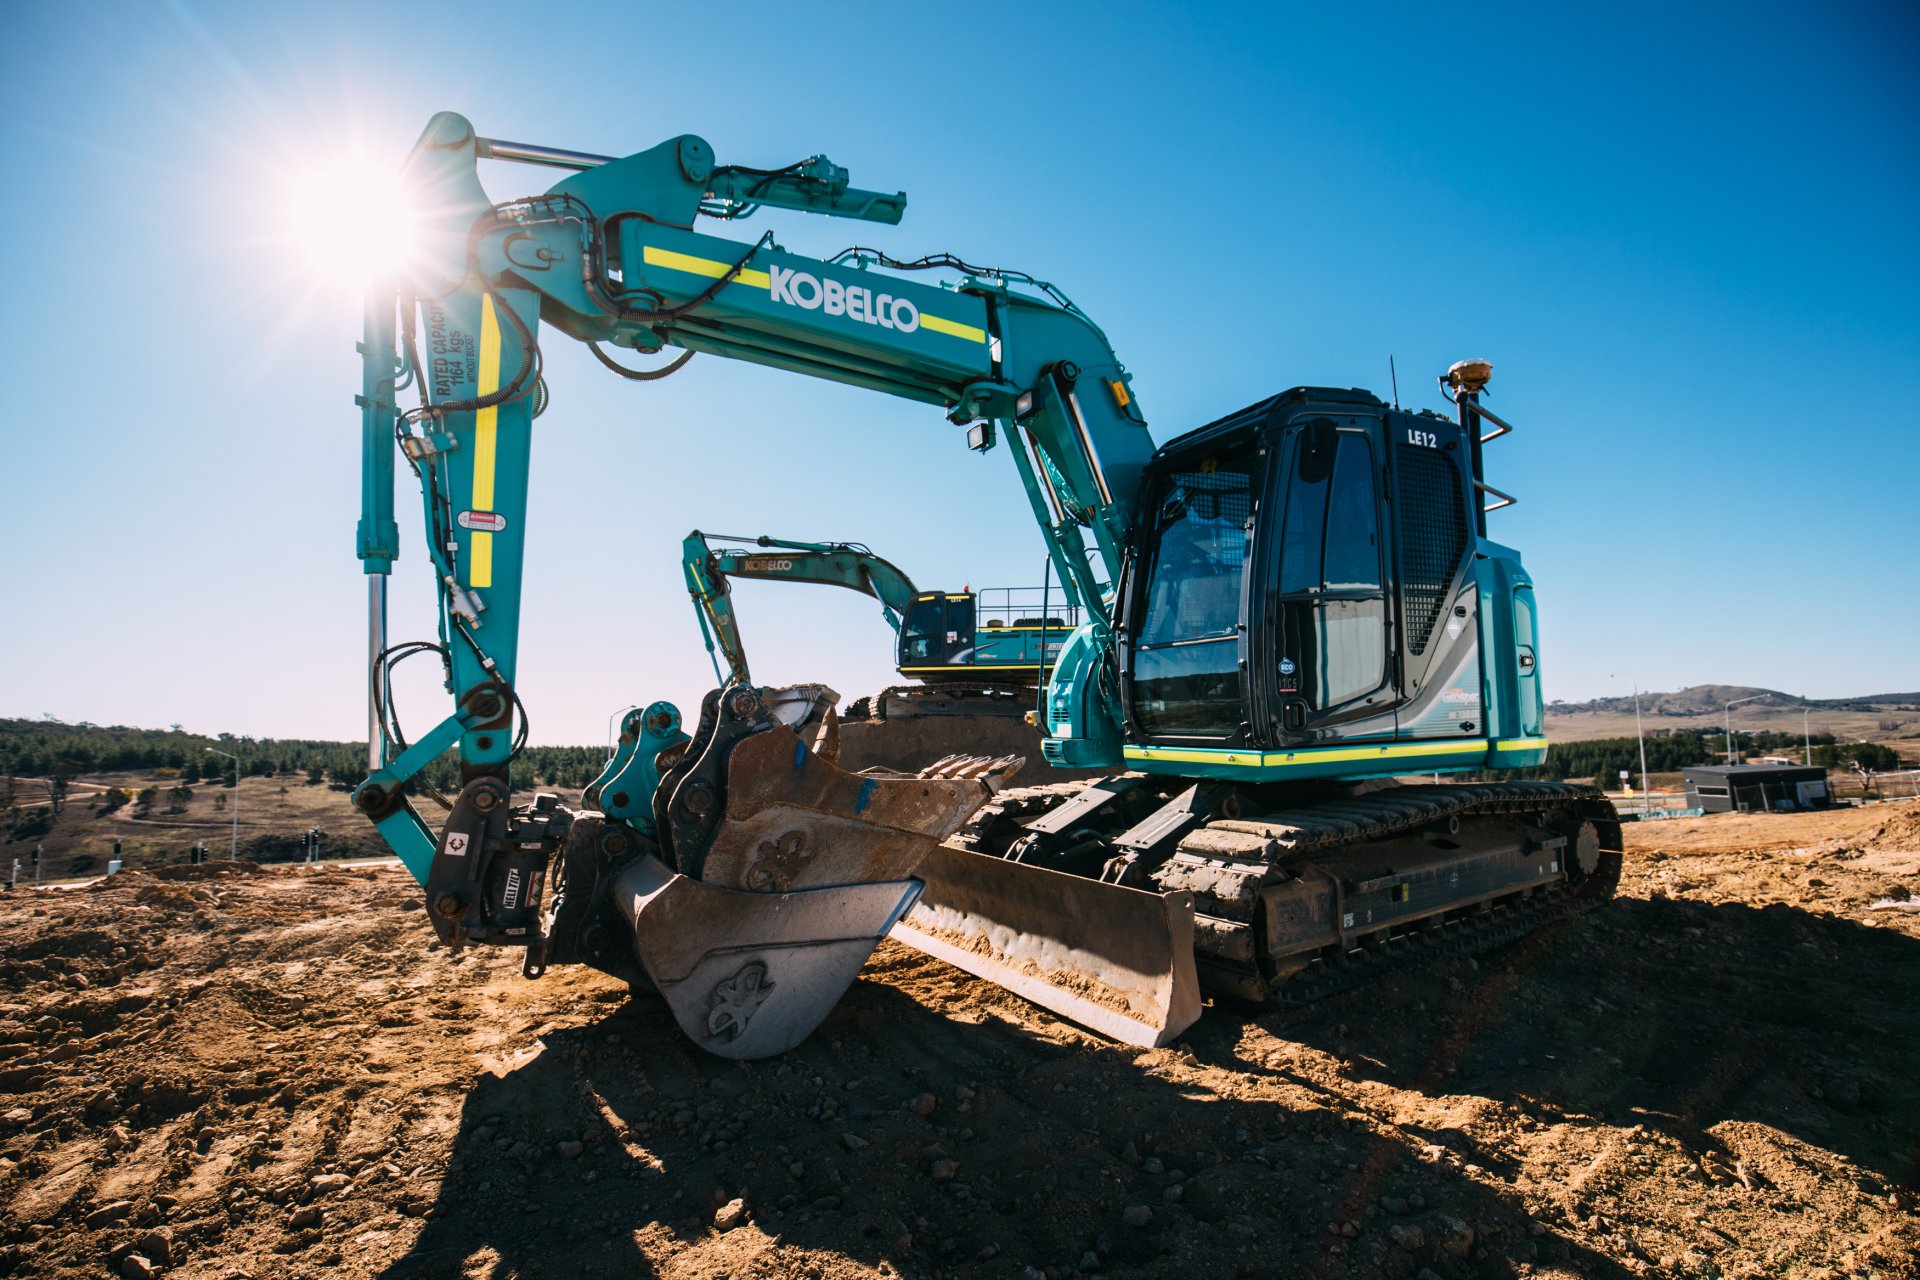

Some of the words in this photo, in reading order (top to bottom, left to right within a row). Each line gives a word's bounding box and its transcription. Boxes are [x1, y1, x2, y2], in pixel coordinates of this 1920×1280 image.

[770, 264, 920, 333] KOBELCO
[430, 300, 447, 354] CAPACIT
[448, 330, 464, 353] kgs
[433, 358, 451, 396] RATED
[449, 361, 464, 386] 1164
[466, 357, 477, 383] WITHOUT
[1407, 429, 1437, 448] LE12
[745, 560, 792, 571] KOBELCO
